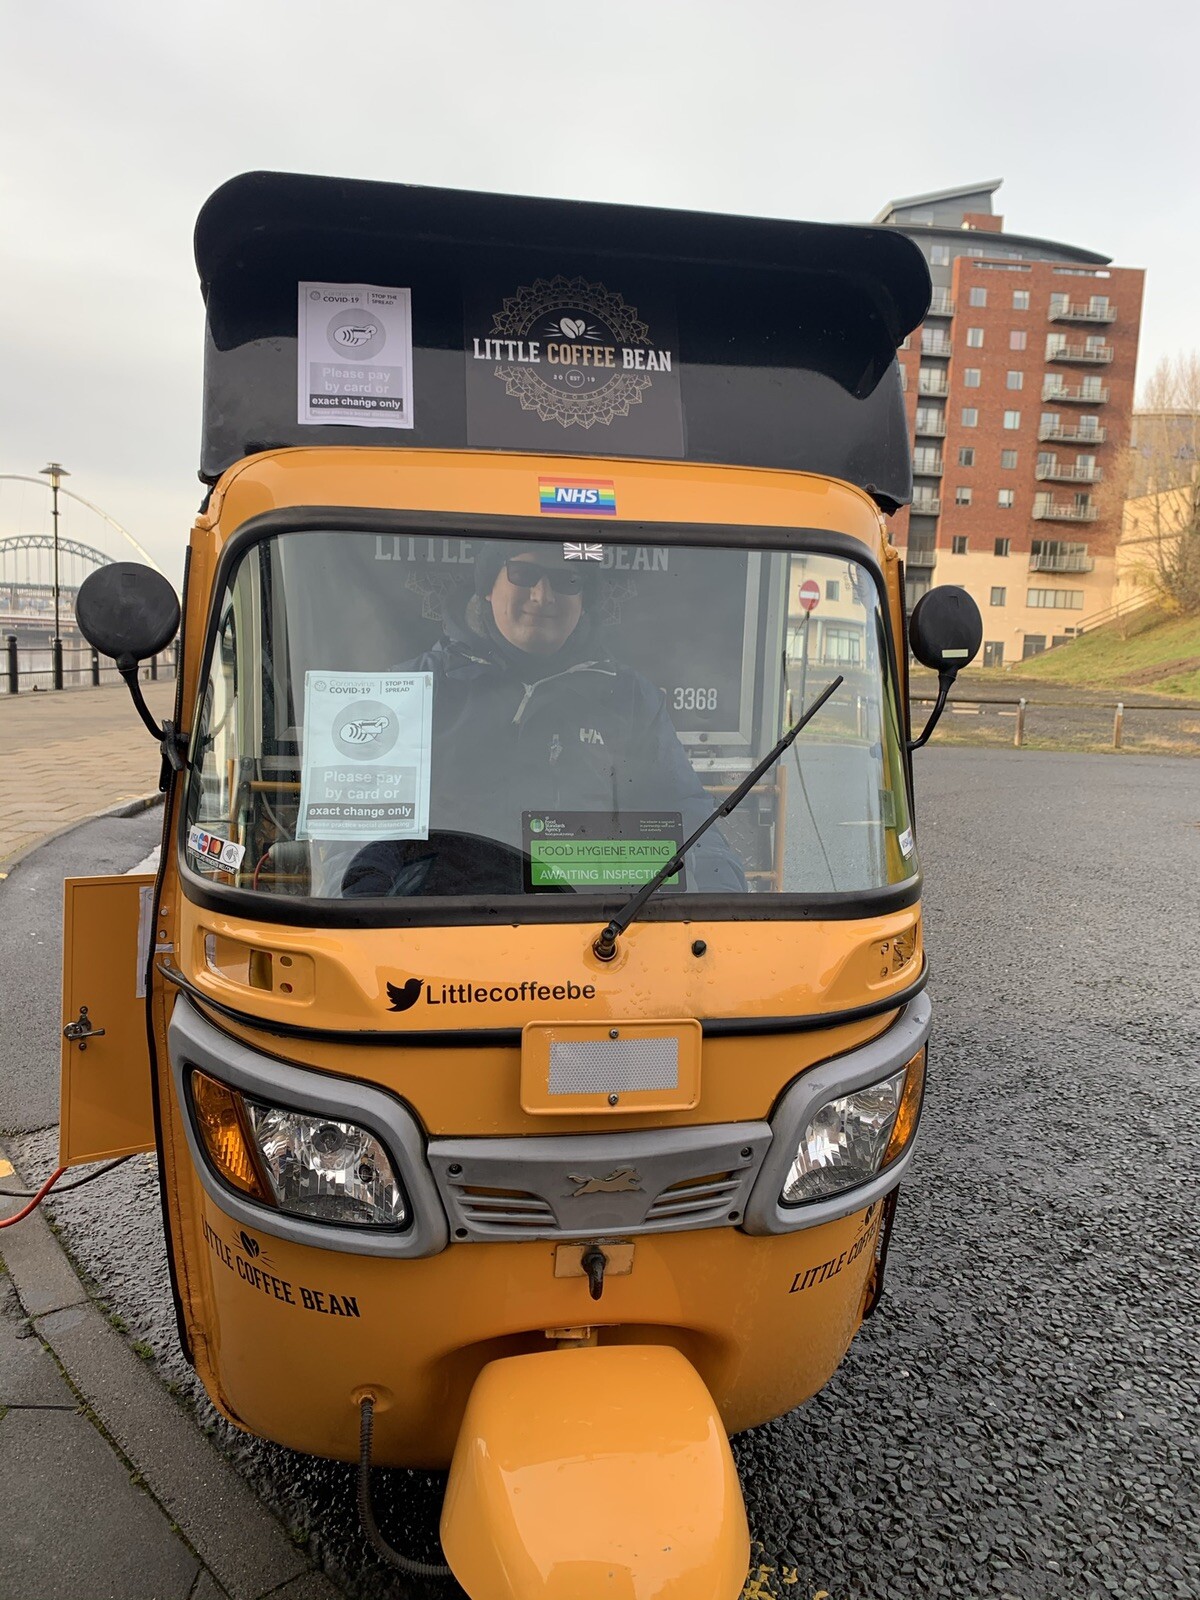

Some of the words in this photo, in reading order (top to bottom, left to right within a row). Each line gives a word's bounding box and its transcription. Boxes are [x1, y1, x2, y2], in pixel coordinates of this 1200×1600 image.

[473, 338, 541, 363] LITTLE
[547, 343, 616, 368] COFFEE
[621, 348, 672, 372] BEAN
[323, 367, 365, 379] Please
[368, 371, 391, 382] pay
[325, 381, 340, 393] by
[344, 383, 371, 393] card
[375, 385, 390, 394] or
[312, 397, 339, 405] exact
[341, 398, 377, 409] change
[379, 400, 401, 410] only
[556, 488, 598, 504] NHS
[374, 536, 475, 564] LITTLE
[600, 546, 669, 571] BEAN
[673, 687, 717, 710] 3368
[324, 771, 372, 783] Please
[376, 772, 402, 785] pay
[326, 788, 342, 801] by
[347, 788, 380, 799] card
[384, 789, 400, 799] or
[309, 807, 340, 816] exact
[343, 806, 385, 818] change
[388, 805, 412, 817] only
[538, 846, 574, 856] FOOD
[577, 846, 626, 856] HYGIENE
[629, 846, 670, 856] RATING
[540, 869, 599, 880] AWAITING
[603, 869, 664, 880] INSPECTI
[426, 980, 596, 1004] Littlecoffeebe
[201, 1214, 234, 1271] LITTLE
[236, 1255, 296, 1305] COFFEE
[299, 1287, 361, 1318] BEAN
[788, 1251, 848, 1294] LITTLE
